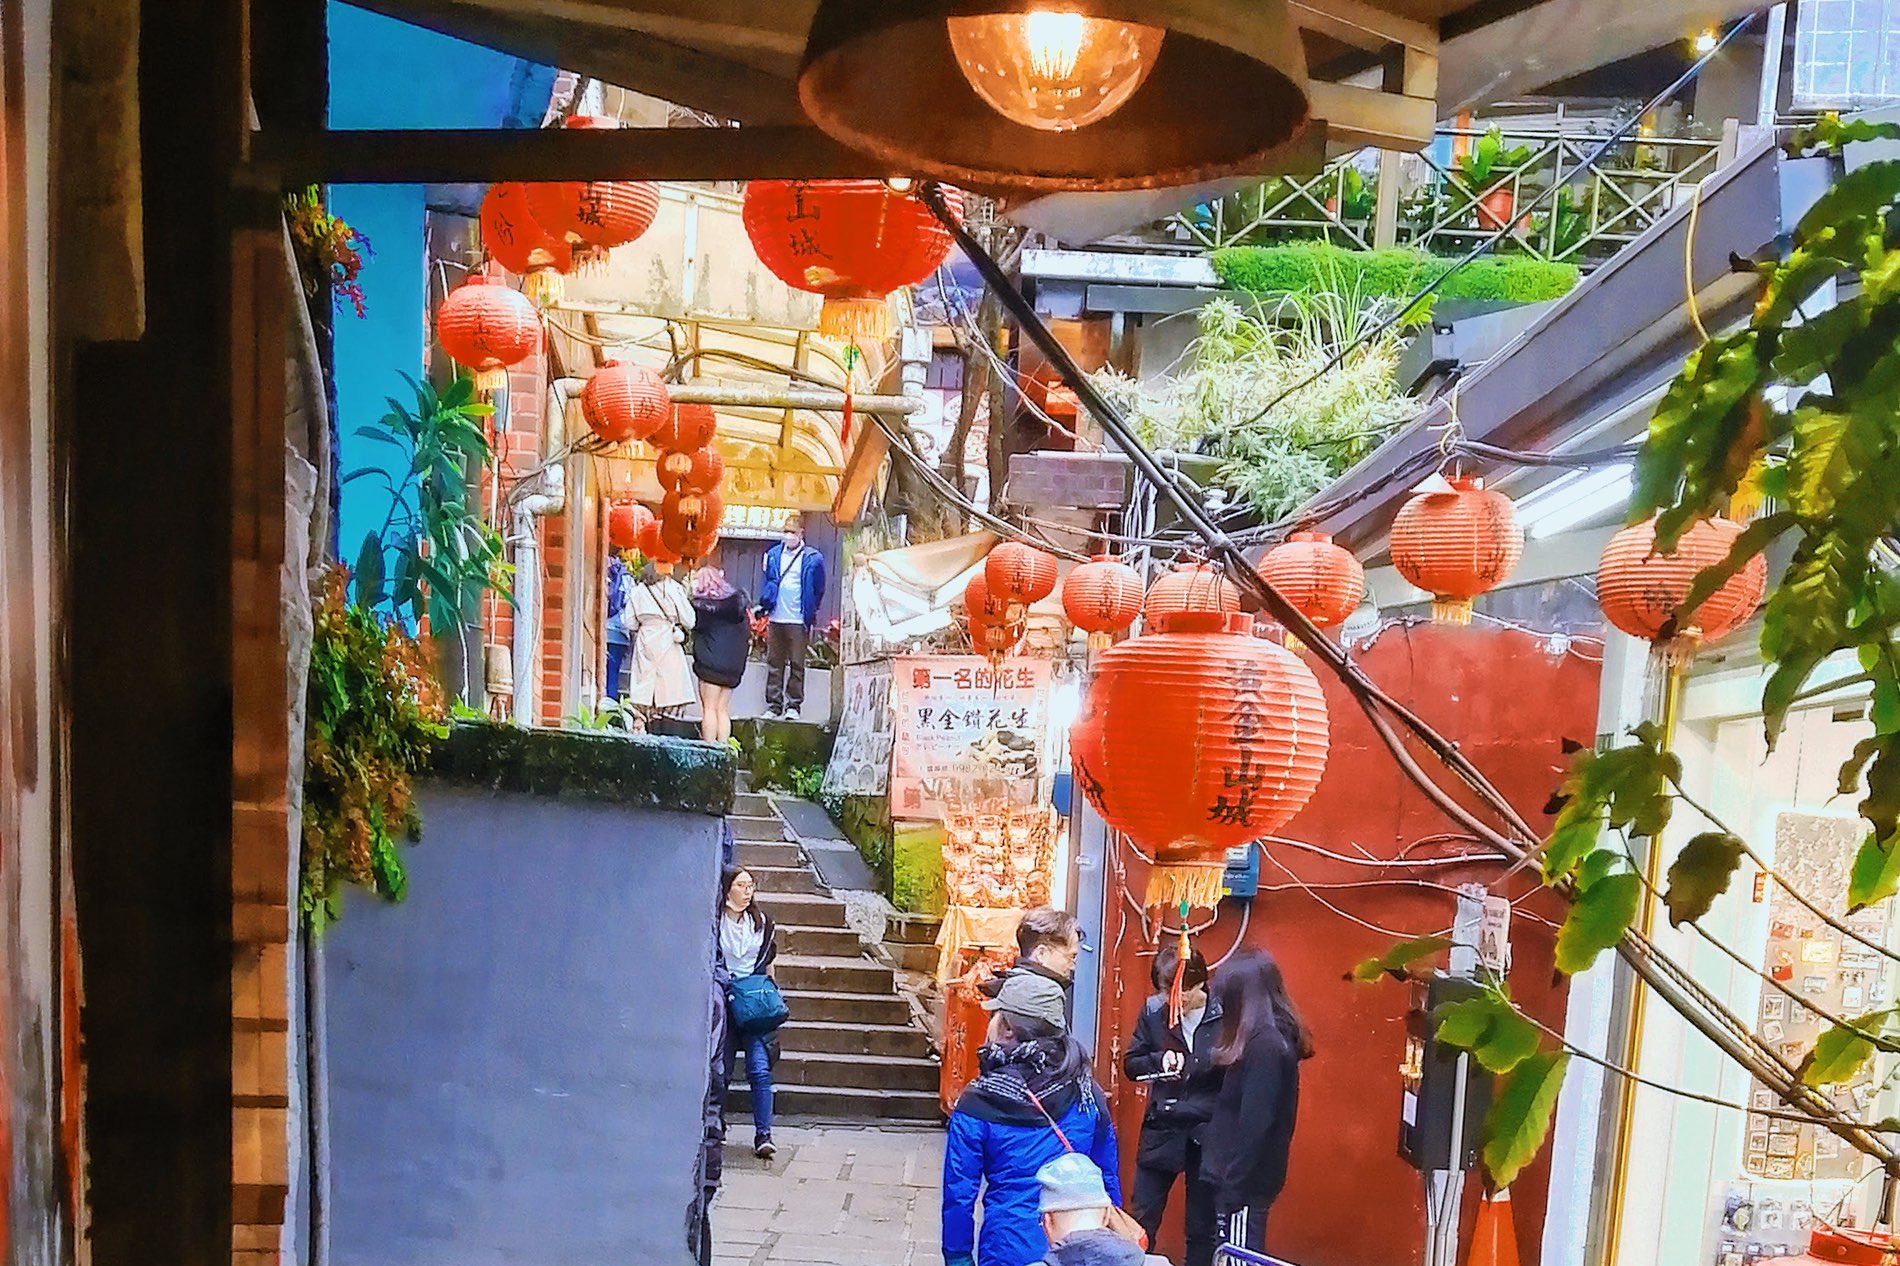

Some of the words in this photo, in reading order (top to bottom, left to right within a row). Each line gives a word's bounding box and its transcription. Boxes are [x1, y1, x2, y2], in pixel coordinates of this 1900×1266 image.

[913, 667, 1036, 690] 第一名的花生
